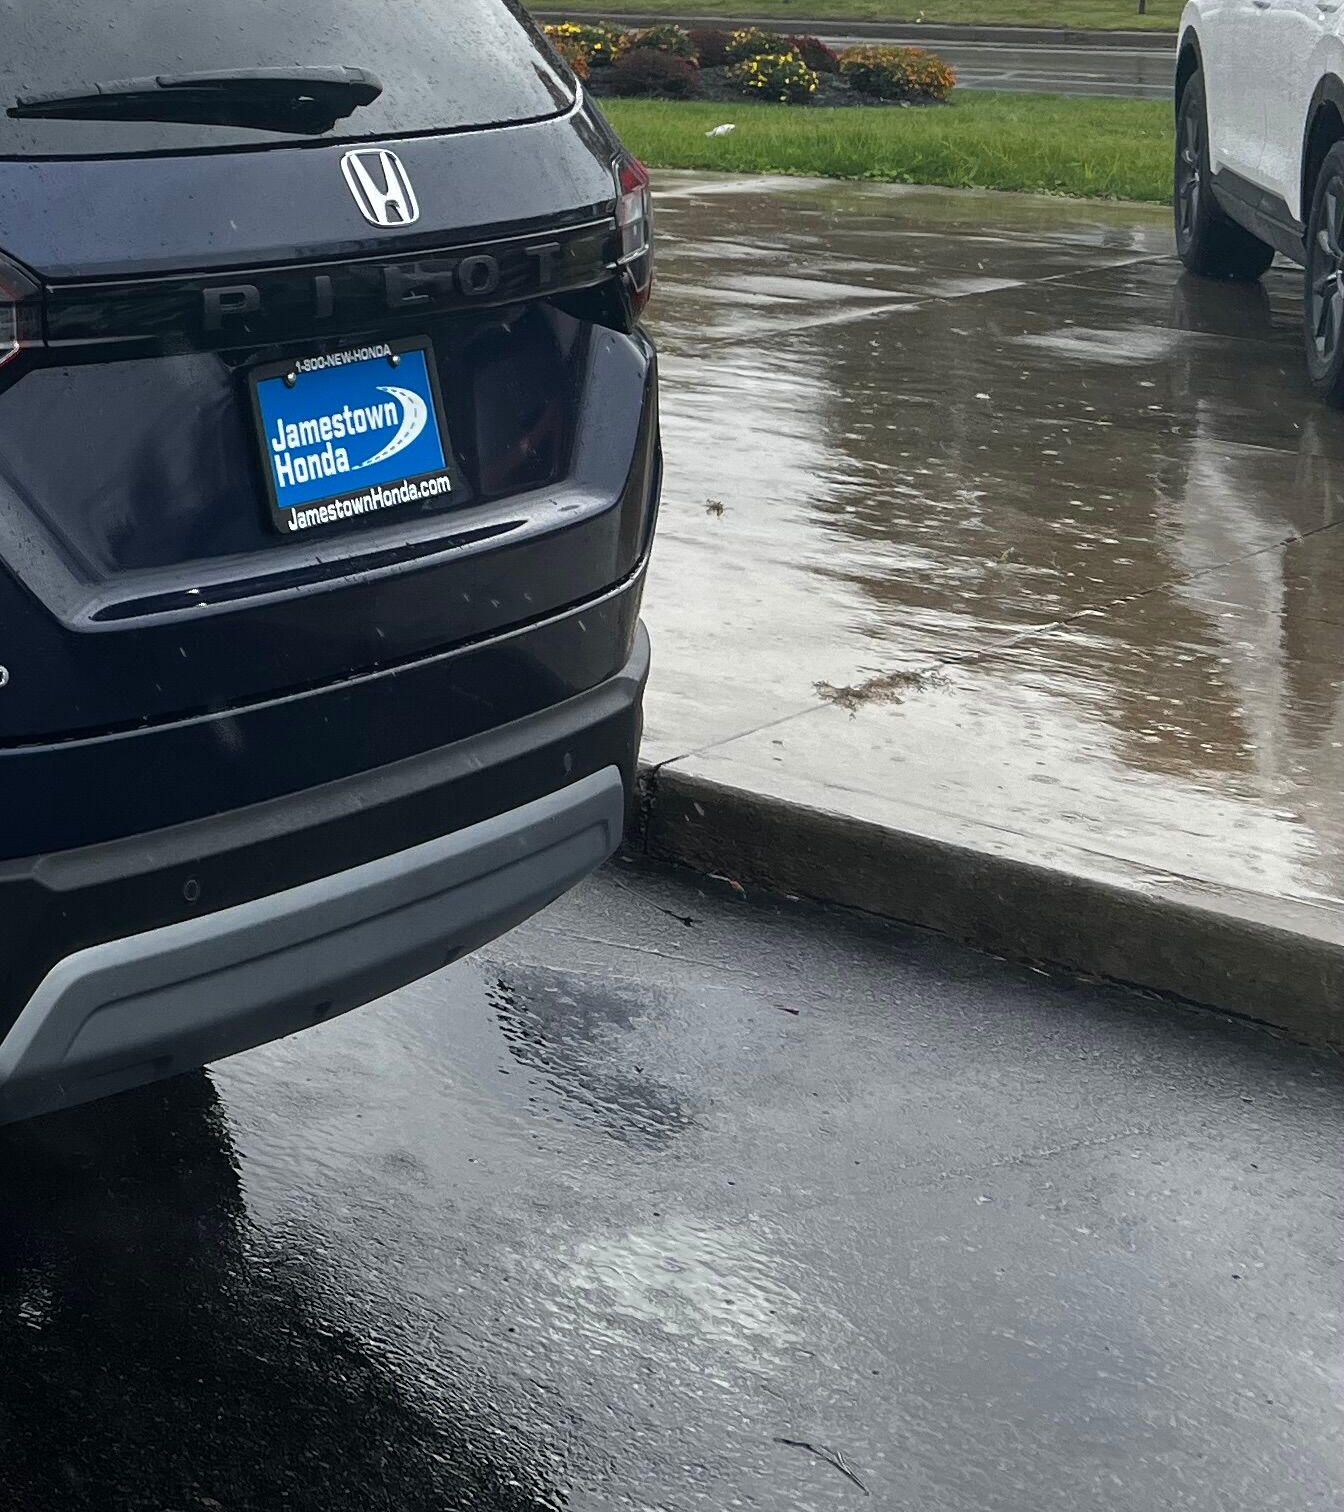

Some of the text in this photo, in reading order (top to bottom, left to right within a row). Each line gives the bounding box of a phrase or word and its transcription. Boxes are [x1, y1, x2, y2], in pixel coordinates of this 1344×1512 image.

[203, 241, 562, 332] PILOT
[295, 343, 392, 373] 1-800-NEW-HONDA
[272, 401, 399, 452] Jamestown
[273, 441, 351, 488] Honda
[287, 474, 452, 531] JamestownHonda.com
